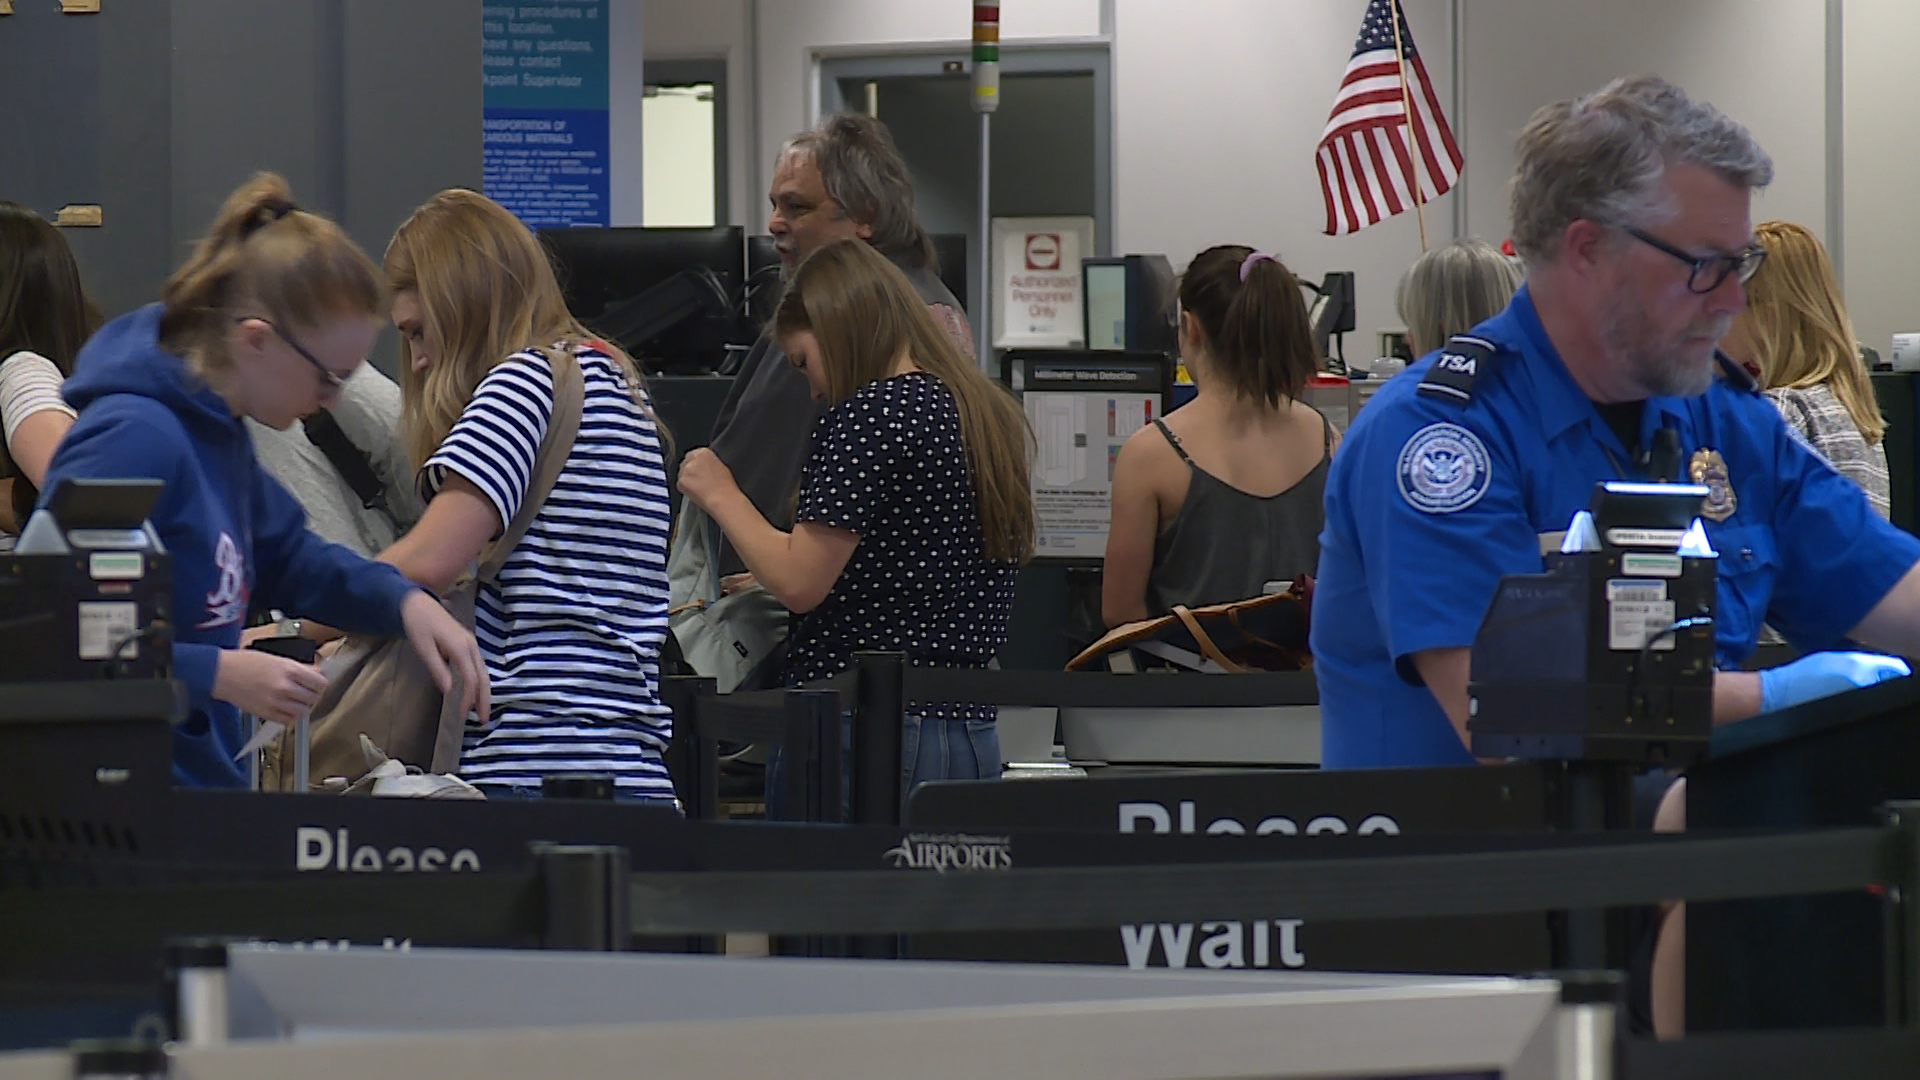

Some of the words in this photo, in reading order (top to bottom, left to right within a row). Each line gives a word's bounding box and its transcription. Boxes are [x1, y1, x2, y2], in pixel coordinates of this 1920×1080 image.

[519, 6, 583, 18] procedures
[587, 7, 598, 18] at
[519, 56, 561, 67] contact
[523, 72, 582, 86] Supervisor
[553, 120, 566, 131] OF
[525, 133, 573, 144] MATERIALS
[1010, 275, 1077, 288] Authorized
[1012, 290, 1073, 303] Personnel
[1028, 305, 1057, 318] Only
[1437, 354, 1477, 376] TSA
[1076, 371, 1099, 380] Wave
[1100, 371, 1137, 380] Detection
[882, 837, 1012, 874] AIRPORTS
[1119, 919, 1305, 970] Wait
